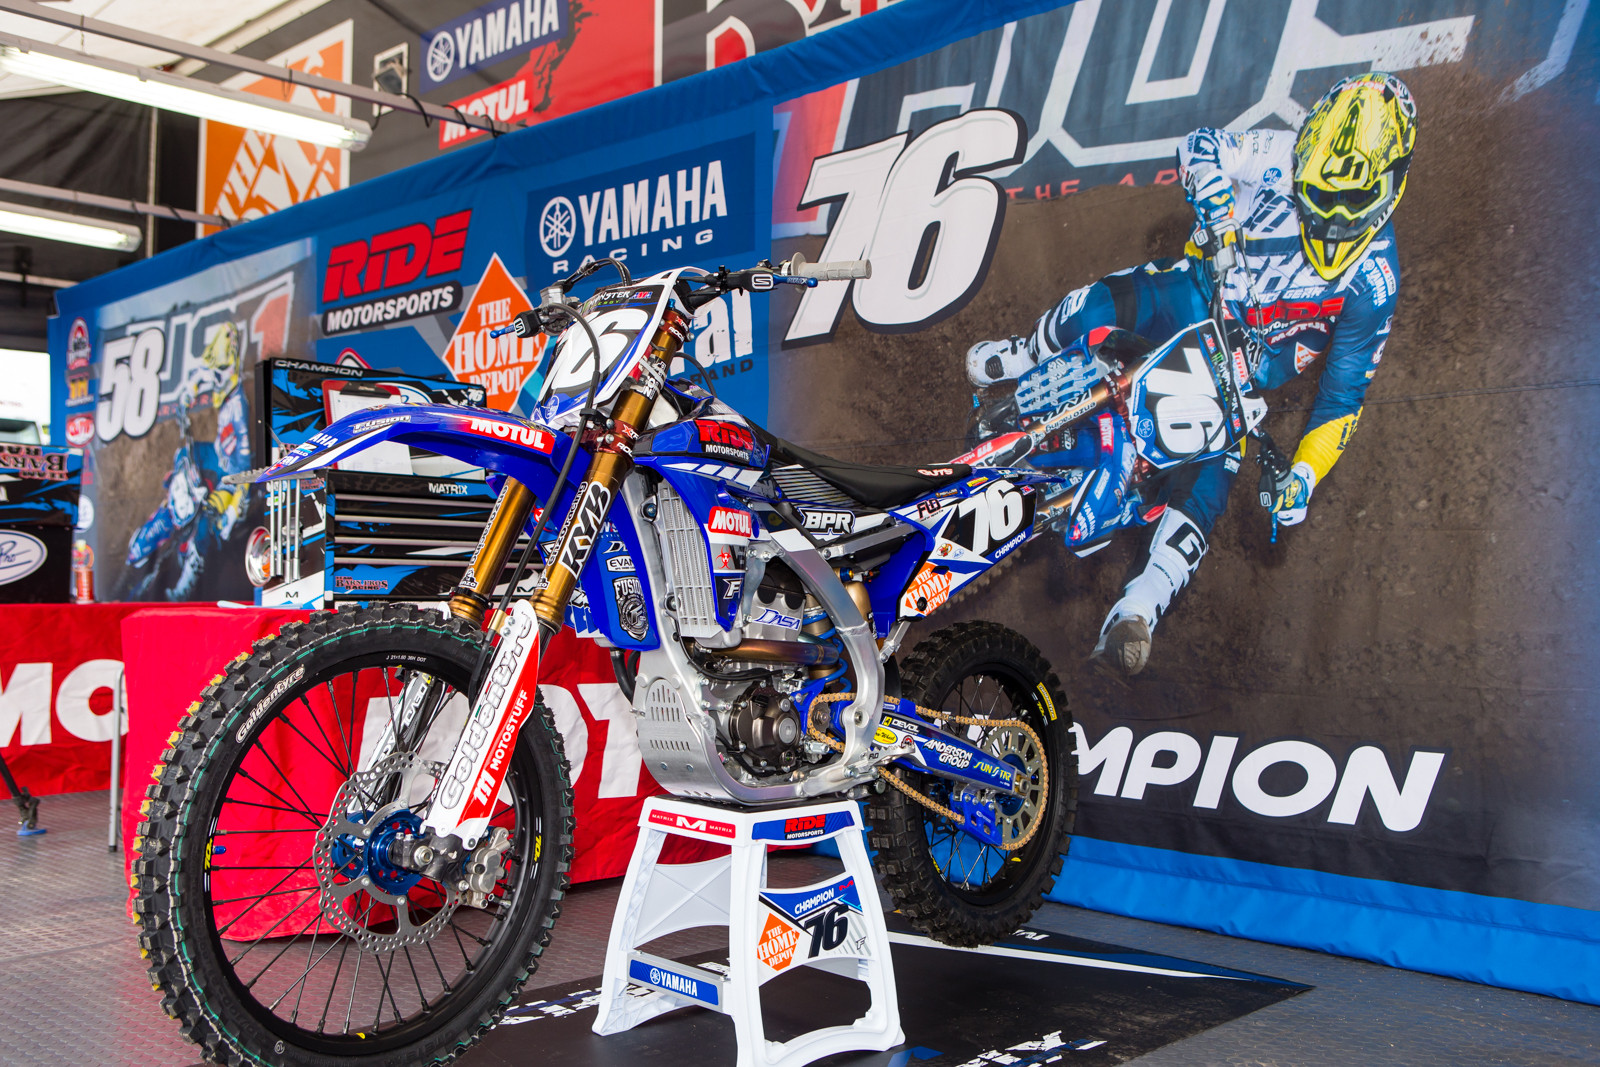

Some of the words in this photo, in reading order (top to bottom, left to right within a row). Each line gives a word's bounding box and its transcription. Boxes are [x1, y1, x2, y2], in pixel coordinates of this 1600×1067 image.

[456, 0, 559, 69] YAMAHA
[578, 160, 727, 247] YAMAHA
[785, 108, 1021, 342] 76
[322, 209, 472, 304] RIDE
[553, 229, 713, 274] RACING
[327, 286, 455, 333] MOTORSPORTS
[477, 297, 511, 326] THE
[1271, 321, 1327, 344] MOTUL
[453, 324, 549, 372] HOME
[274, 359, 364, 377] CHAMPION
[469, 366, 524, 396] DEPOT
[97, 328, 164, 442] 58
[467, 388, 484, 403] 76
[1145, 347, 1227, 454] 76
[471, 418, 545, 450] MOTUL
[695, 419, 755, 450] RIDE
[705, 444, 749, 461] MOTORSPORTS
[917, 468, 954, 477] GUTS
[428, 482, 468, 495] MATRIX
[558, 481, 611, 580] KYB
[712, 510, 751, 532] MOTUL
[809, 511, 852, 533] BPR
[958, 480, 1023, 555] 76
[995, 531, 1026, 560] CHAMPION
[906, 573, 952, 609] HOME
[915, 567, 933, 586] THE
[236, 663, 305, 744] Goldentyre
[441, 610, 531, 811] Goldentyre
[493, 689, 529, 771] MOTOSTUFF
[891, 719, 920, 735] DEVOL
[924, 739, 973, 761] ANDERSON
[938, 753, 970, 770] GROUP
[651, 814, 674, 823] MATRIX
[709, 825, 733, 834] MATRIX
[784, 814, 826, 833] RIDE
[786, 829, 824, 840] MOTORSPORTS
[794, 887, 835, 915] CHAMPION
[757, 930, 797, 962] HOME
[766, 925, 783, 938] THE
[803, 904, 850, 959] 76
[768, 948, 794, 967] DEPOT
[660, 970, 698, 998] YAMAHA
